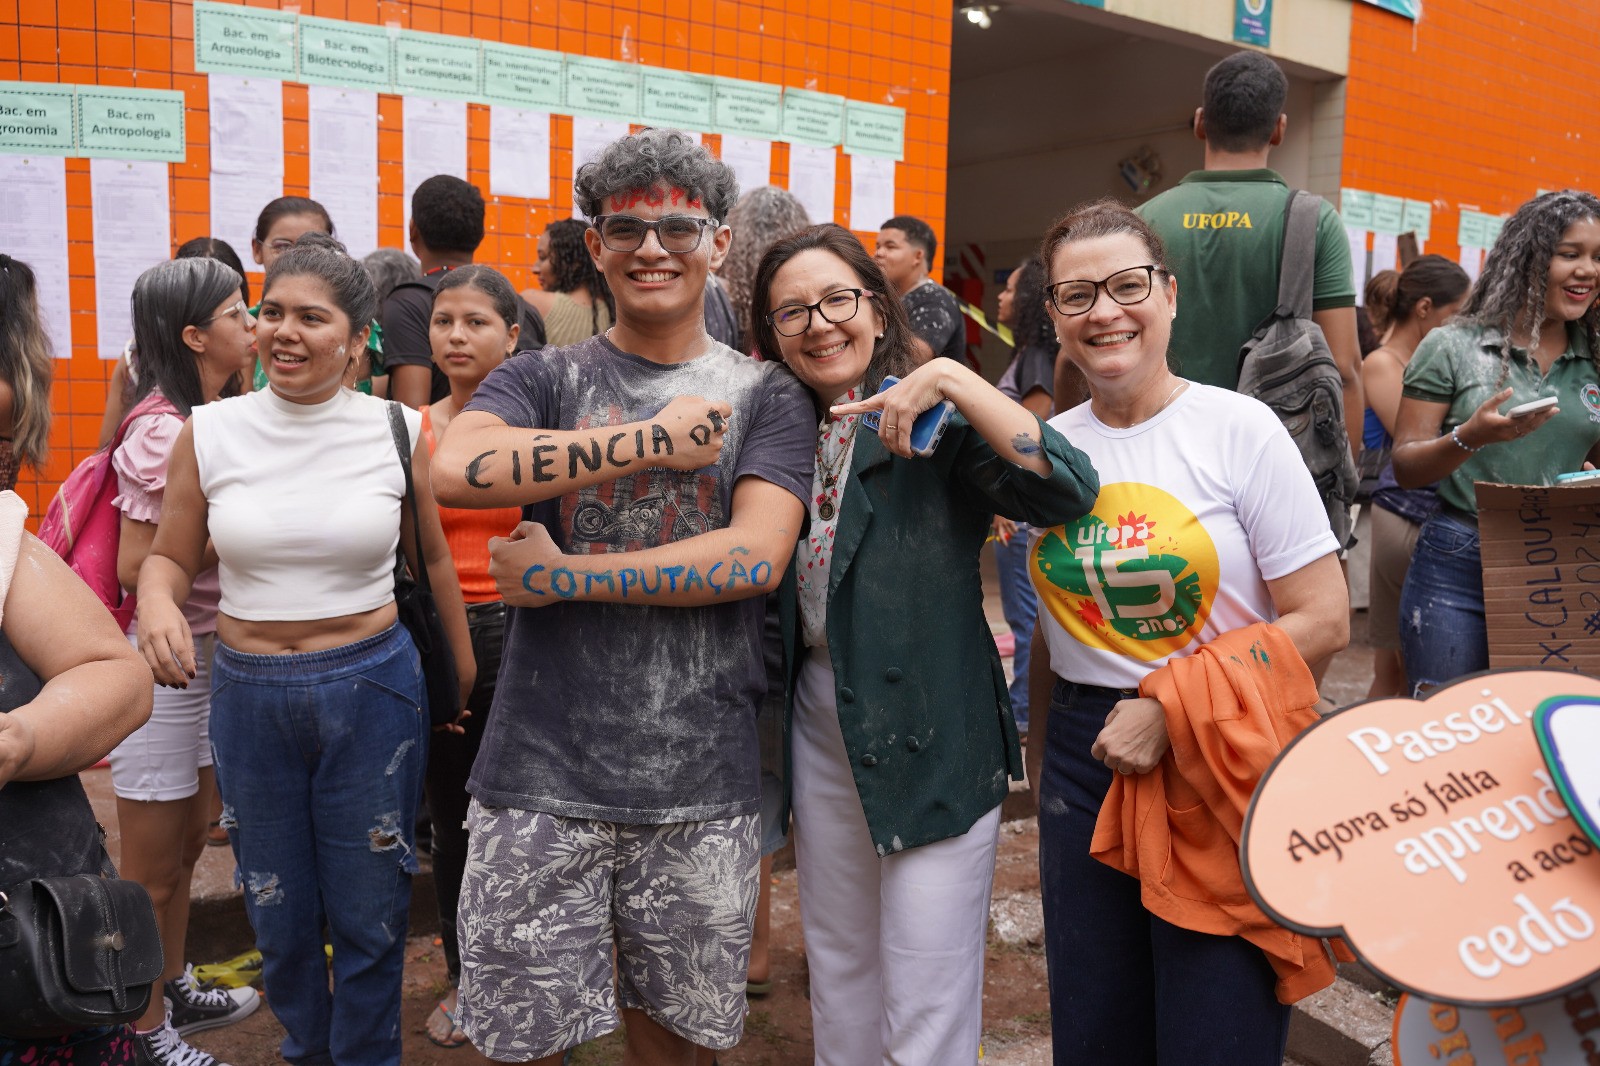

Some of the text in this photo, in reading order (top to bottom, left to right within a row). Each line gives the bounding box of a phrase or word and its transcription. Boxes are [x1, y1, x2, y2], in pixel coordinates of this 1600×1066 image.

[223, 27, 269, 42] Bac. em
[211, 42, 281, 60] Arqueologia
[324, 39, 369, 54] Bac. em
[26, 108, 46, 117] em
[107, 108, 155, 121] Bac. em
[92, 124, 171, 141] Antropologia
[1183, 212, 1252, 230] UFOPA
[465, 424, 674, 490] CIÊNCIA
[1077, 522, 1149, 547] ufopa
[522, 546, 773, 599] COMPUTAÇÃO
[1075, 545, 1176, 620] 15
[1136, 615, 1188, 635] anos
[1287, 766, 1501, 862] Agora só falta
[1507, 860, 1534, 883] a
[1458, 894, 1596, 979] cedo
